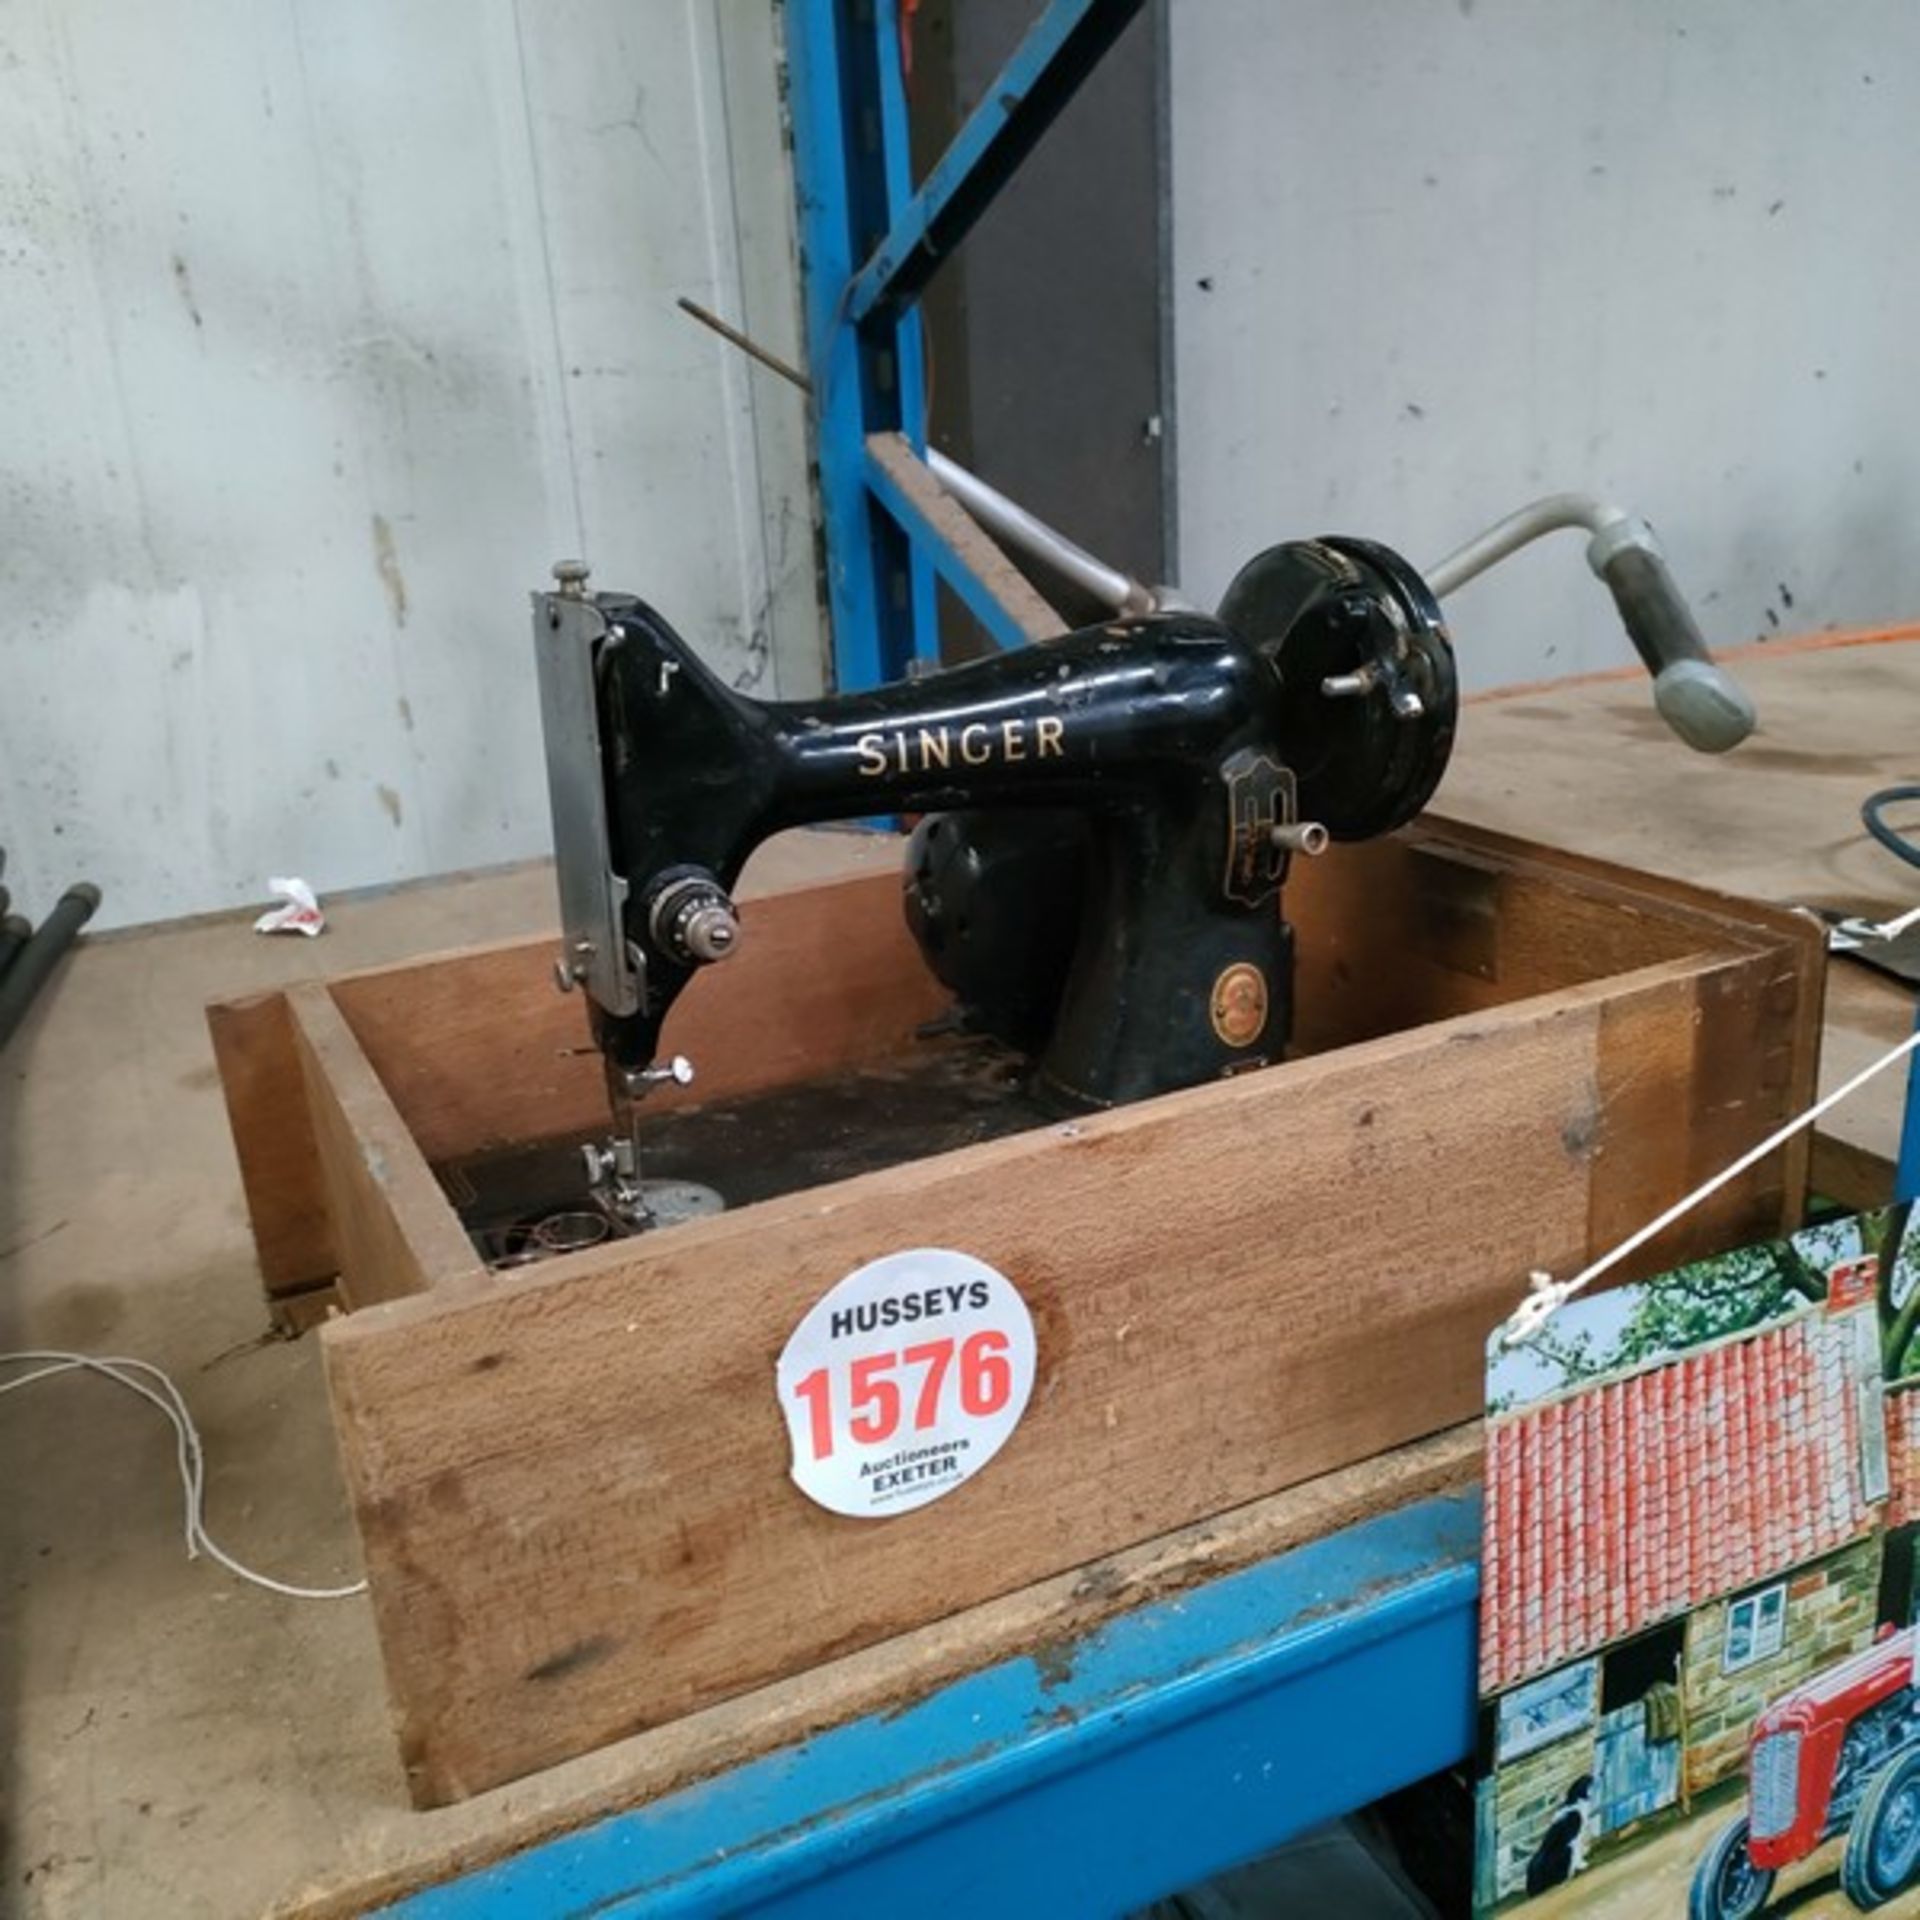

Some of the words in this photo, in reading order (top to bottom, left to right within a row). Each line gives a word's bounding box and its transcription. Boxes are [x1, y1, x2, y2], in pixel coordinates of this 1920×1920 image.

[856, 716, 1065, 776] SINGER
[831, 1281, 990, 1338] HUSSEYS
[794, 1330, 1011, 1461] 1576
[860, 1438, 970, 1477] Auctioneers
[873, 1455, 958, 1493] EXETER
